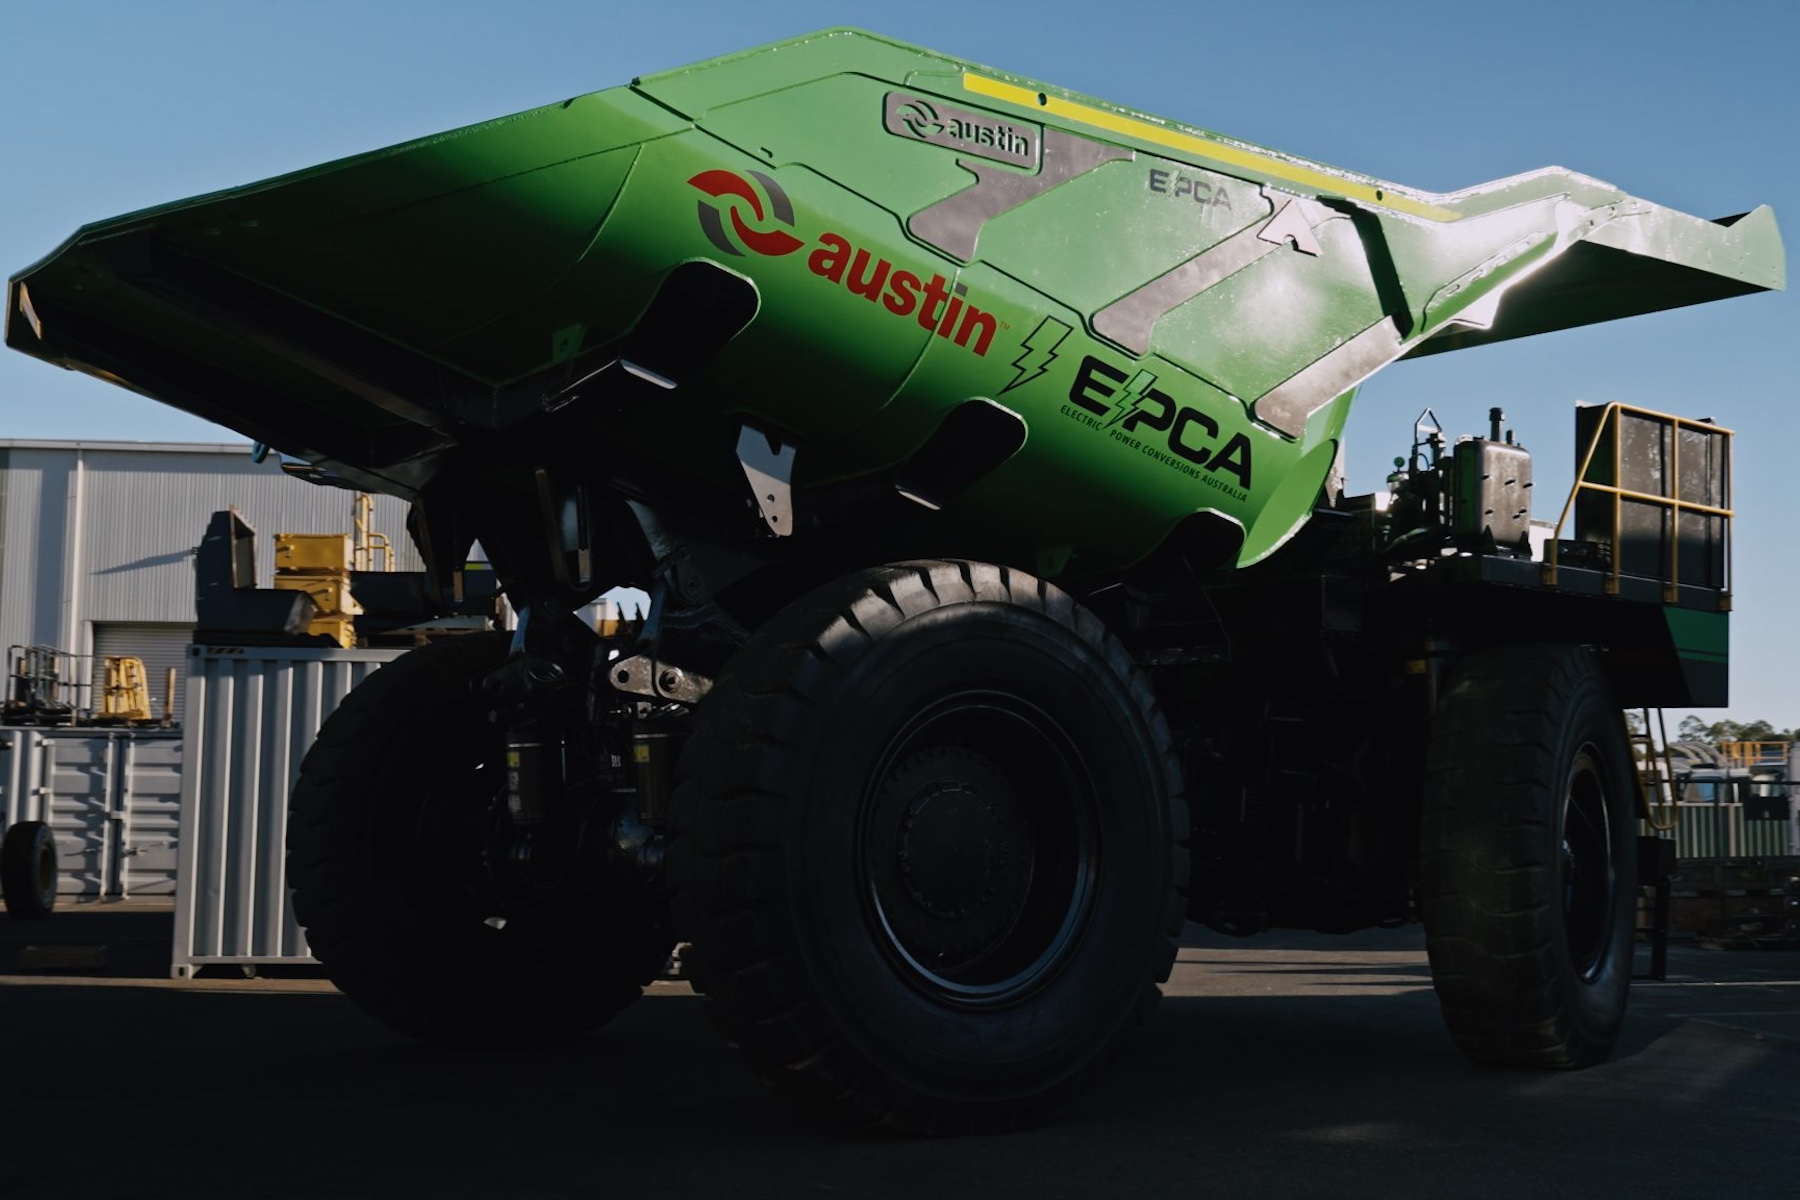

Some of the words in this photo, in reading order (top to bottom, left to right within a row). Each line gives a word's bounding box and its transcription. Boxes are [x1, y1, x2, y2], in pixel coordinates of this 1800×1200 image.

[948, 118, 1030, 157] austin
[808, 232, 997, 358] austin
[1060, 405, 1103, 431] ELECTRIC
[1109, 429, 1141, 450] POWER
[1142, 445, 1200, 479] CONVERSIONS
[1200, 474, 1248, 502] AUSTRALIA
[1069, 355, 1250, 490] EPCA
